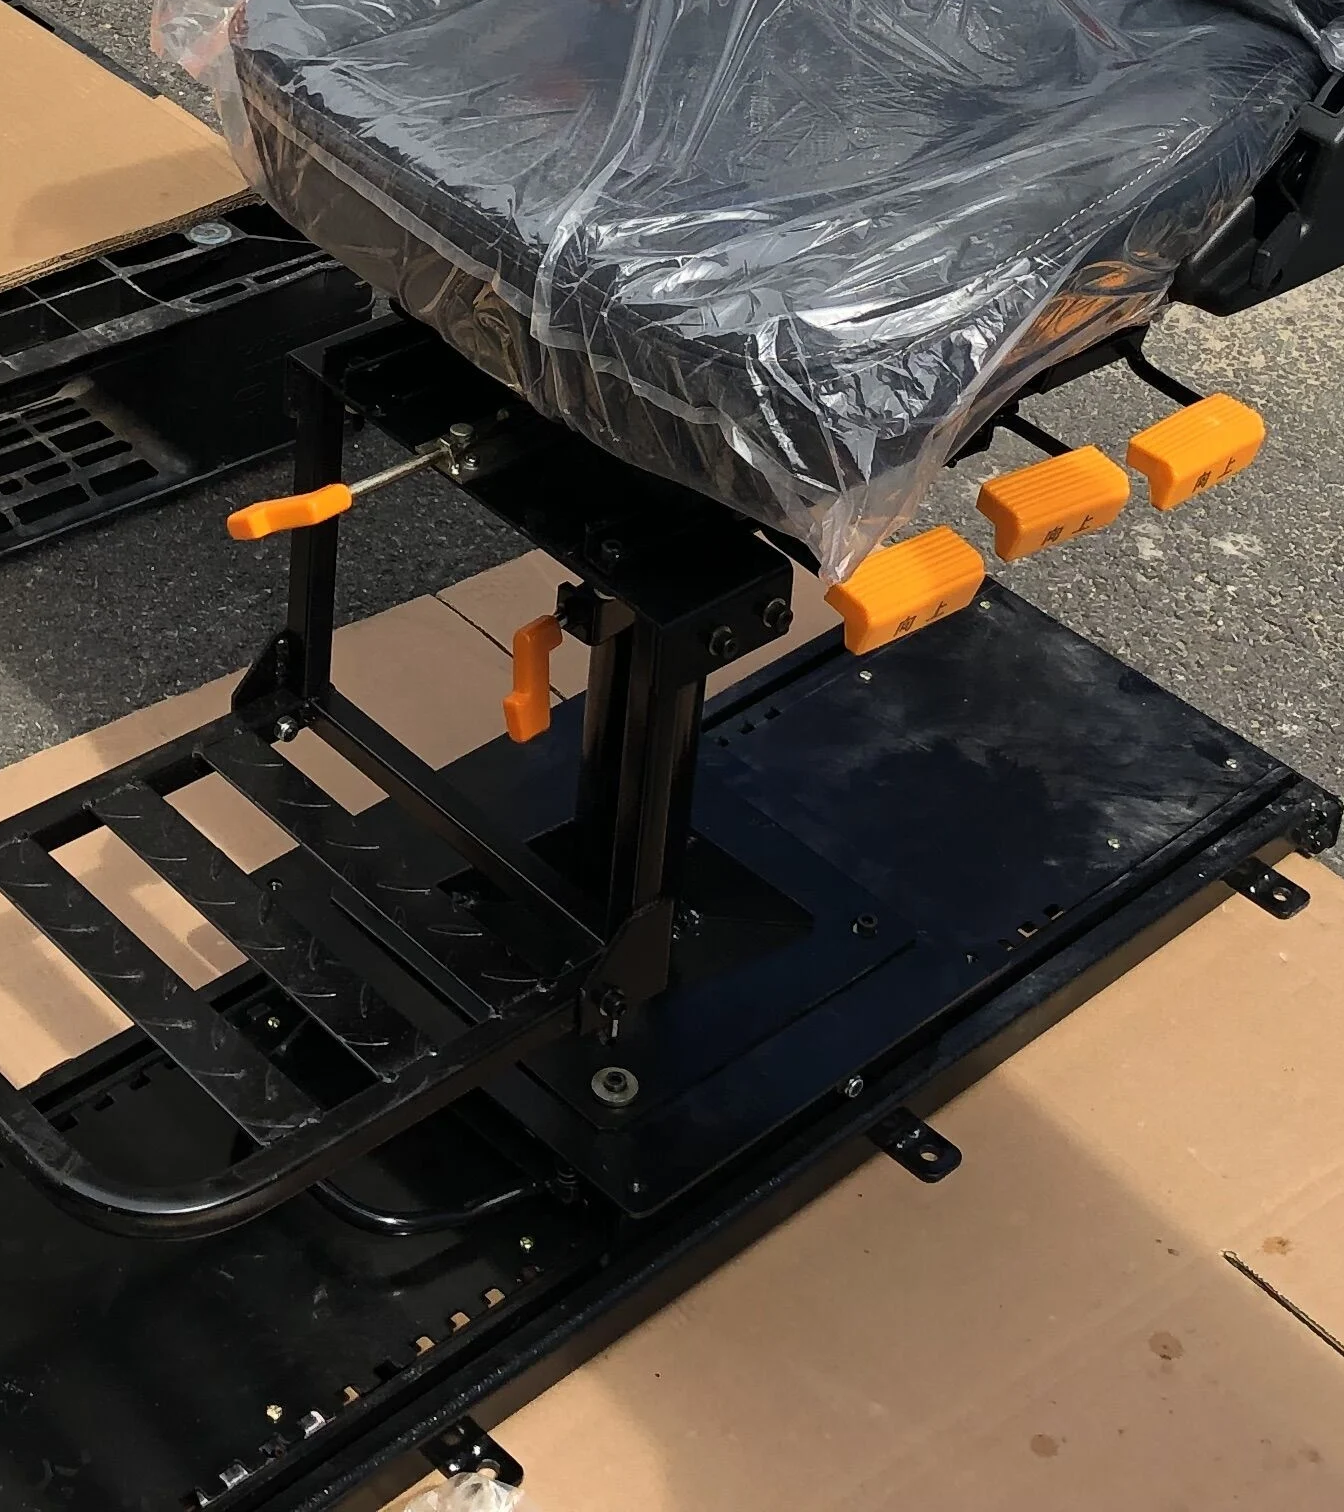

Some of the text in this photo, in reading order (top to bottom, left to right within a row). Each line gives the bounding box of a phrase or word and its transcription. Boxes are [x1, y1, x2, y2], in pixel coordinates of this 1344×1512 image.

[1192, 456, 1236, 493] 向上
[1041, 514, 1095, 546] 向上
[892, 601, 948, 638] 向上
